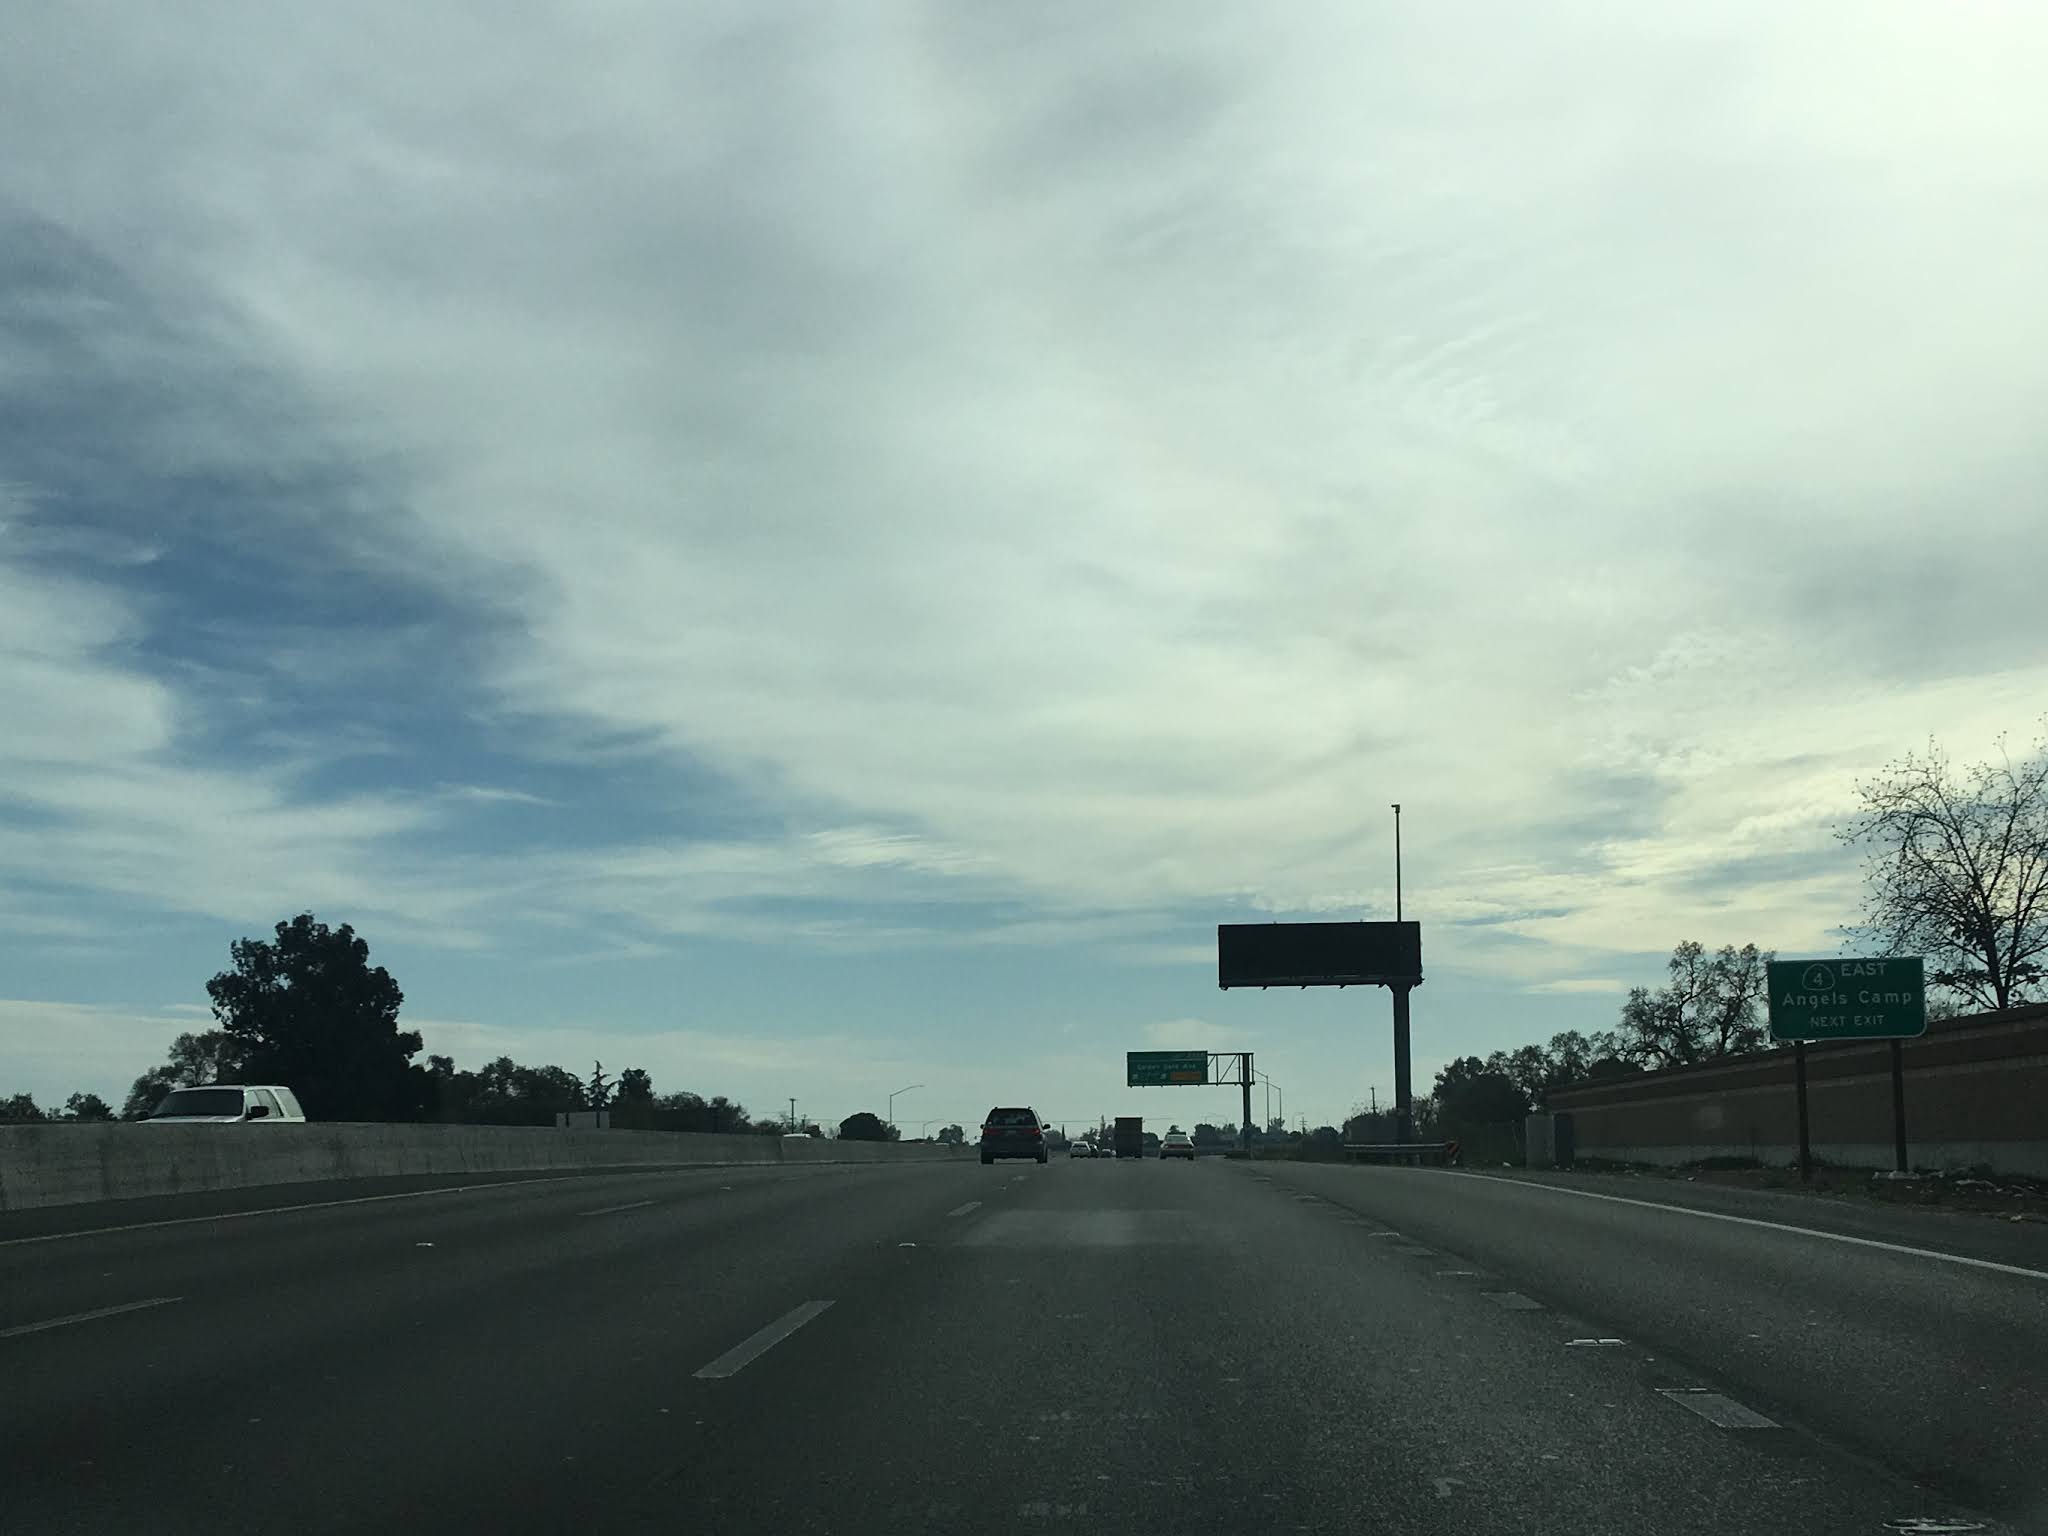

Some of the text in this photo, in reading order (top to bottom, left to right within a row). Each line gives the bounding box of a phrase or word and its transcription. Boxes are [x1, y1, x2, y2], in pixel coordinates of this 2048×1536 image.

[1812, 962, 1888, 986] 4 EAST
[1782, 990, 1912, 1008] Angels Camp
[1809, 1014, 1886, 1028] NEXT EXIT
